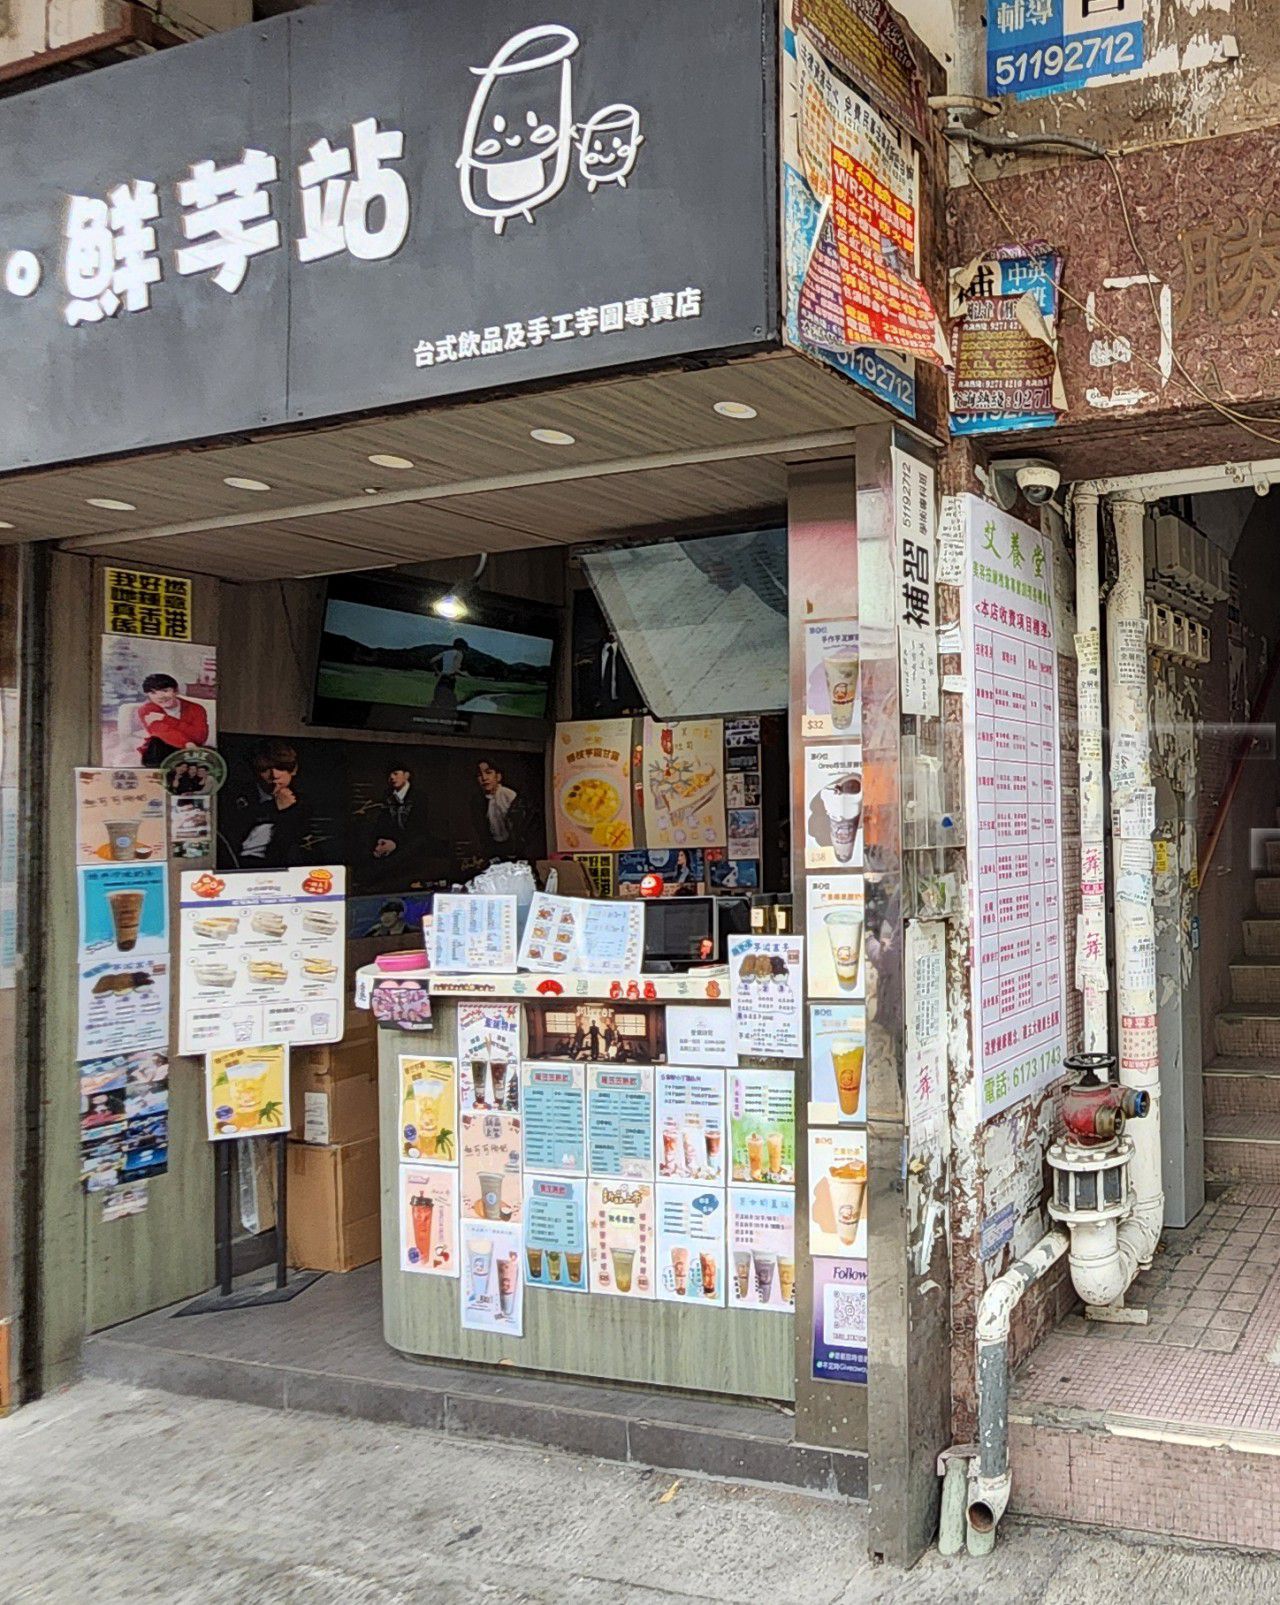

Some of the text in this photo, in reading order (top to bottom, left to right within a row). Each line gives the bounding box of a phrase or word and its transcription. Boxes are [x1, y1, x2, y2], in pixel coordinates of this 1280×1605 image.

[996, 31, 1135, 85] 51192712
[834, 164, 866, 205] WR2
[64, 117, 410, 327] 鮮芋站
[1008, 261, 1047, 288] 中英
[413, 287, 702, 368] 台式飲品及手工芋圓專賣店
[902, 462, 912, 529] 51192712
[903, 538, 930, 629] 補習
[1013, 1057, 1037, 1088] 6173
[1040, 1045, 1061, 1073] 1743
